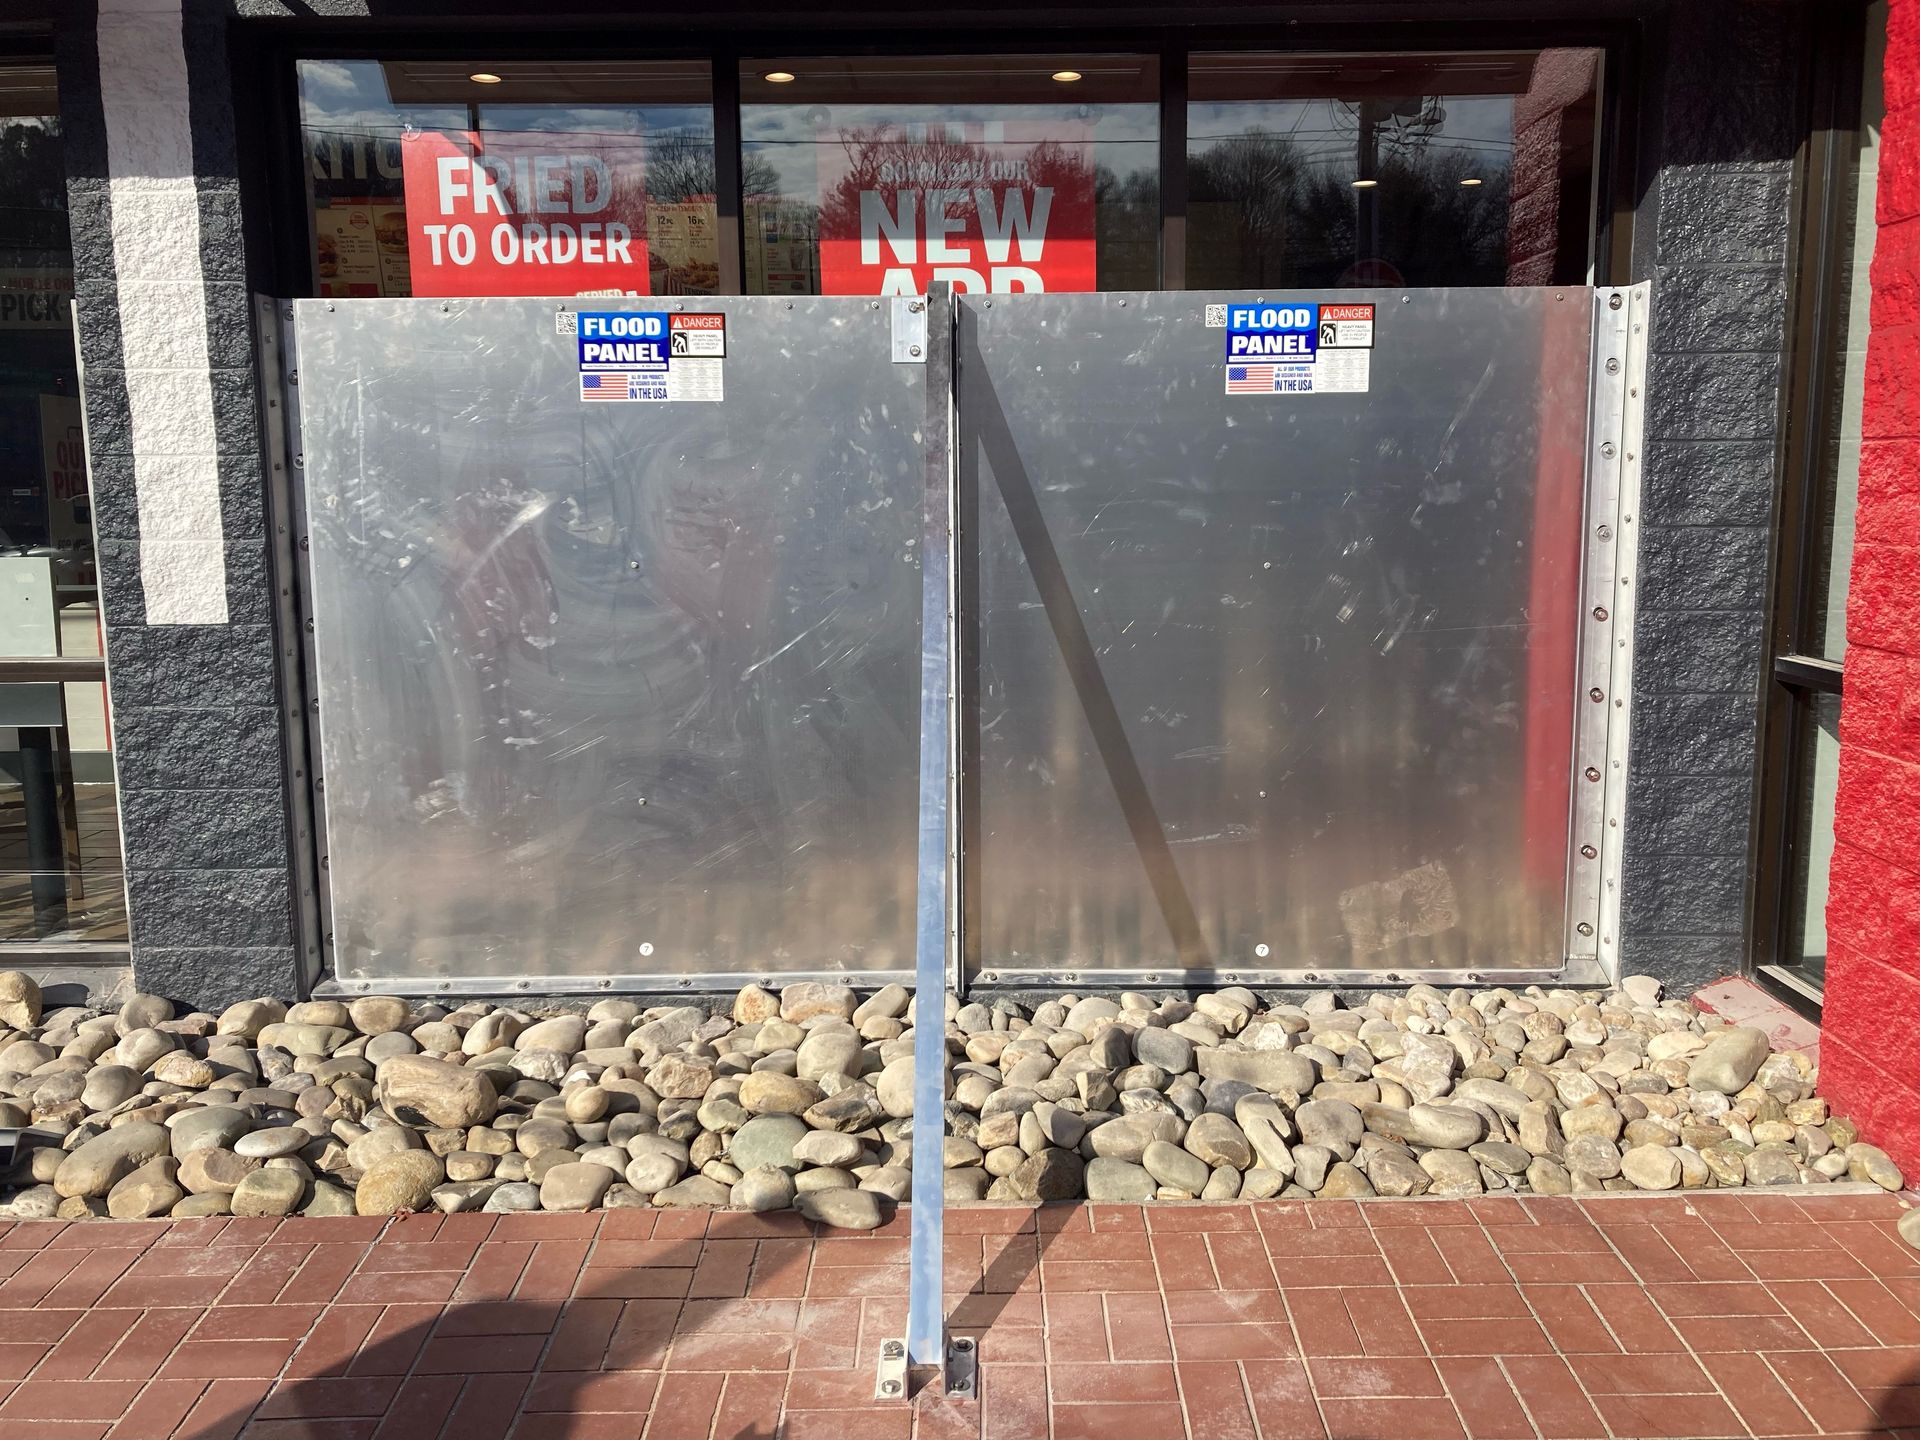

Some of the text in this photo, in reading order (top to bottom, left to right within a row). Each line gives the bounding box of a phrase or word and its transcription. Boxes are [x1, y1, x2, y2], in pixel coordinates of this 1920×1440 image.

[990, 160, 1030, 181] OUR
[437, 155, 613, 216] FRIED
[688, 216, 696, 224] 16
[859, 186, 1055, 265] NEW
[424, 224, 476, 266] TO
[490, 222, 633, 265] ORDER
[683, 317, 722, 328] DANGER
[1233, 308, 1310, 328] FLOOD
[1332, 308, 1371, 319] DANGER
[583, 317, 661, 336] FLOOD
[583, 343, 664, 361] PANEL
[1232, 334, 1311, 354] PANEL
[629, 388, 668, 399] IN THE USA
[1275, 380, 1312, 391] IN THE USA
